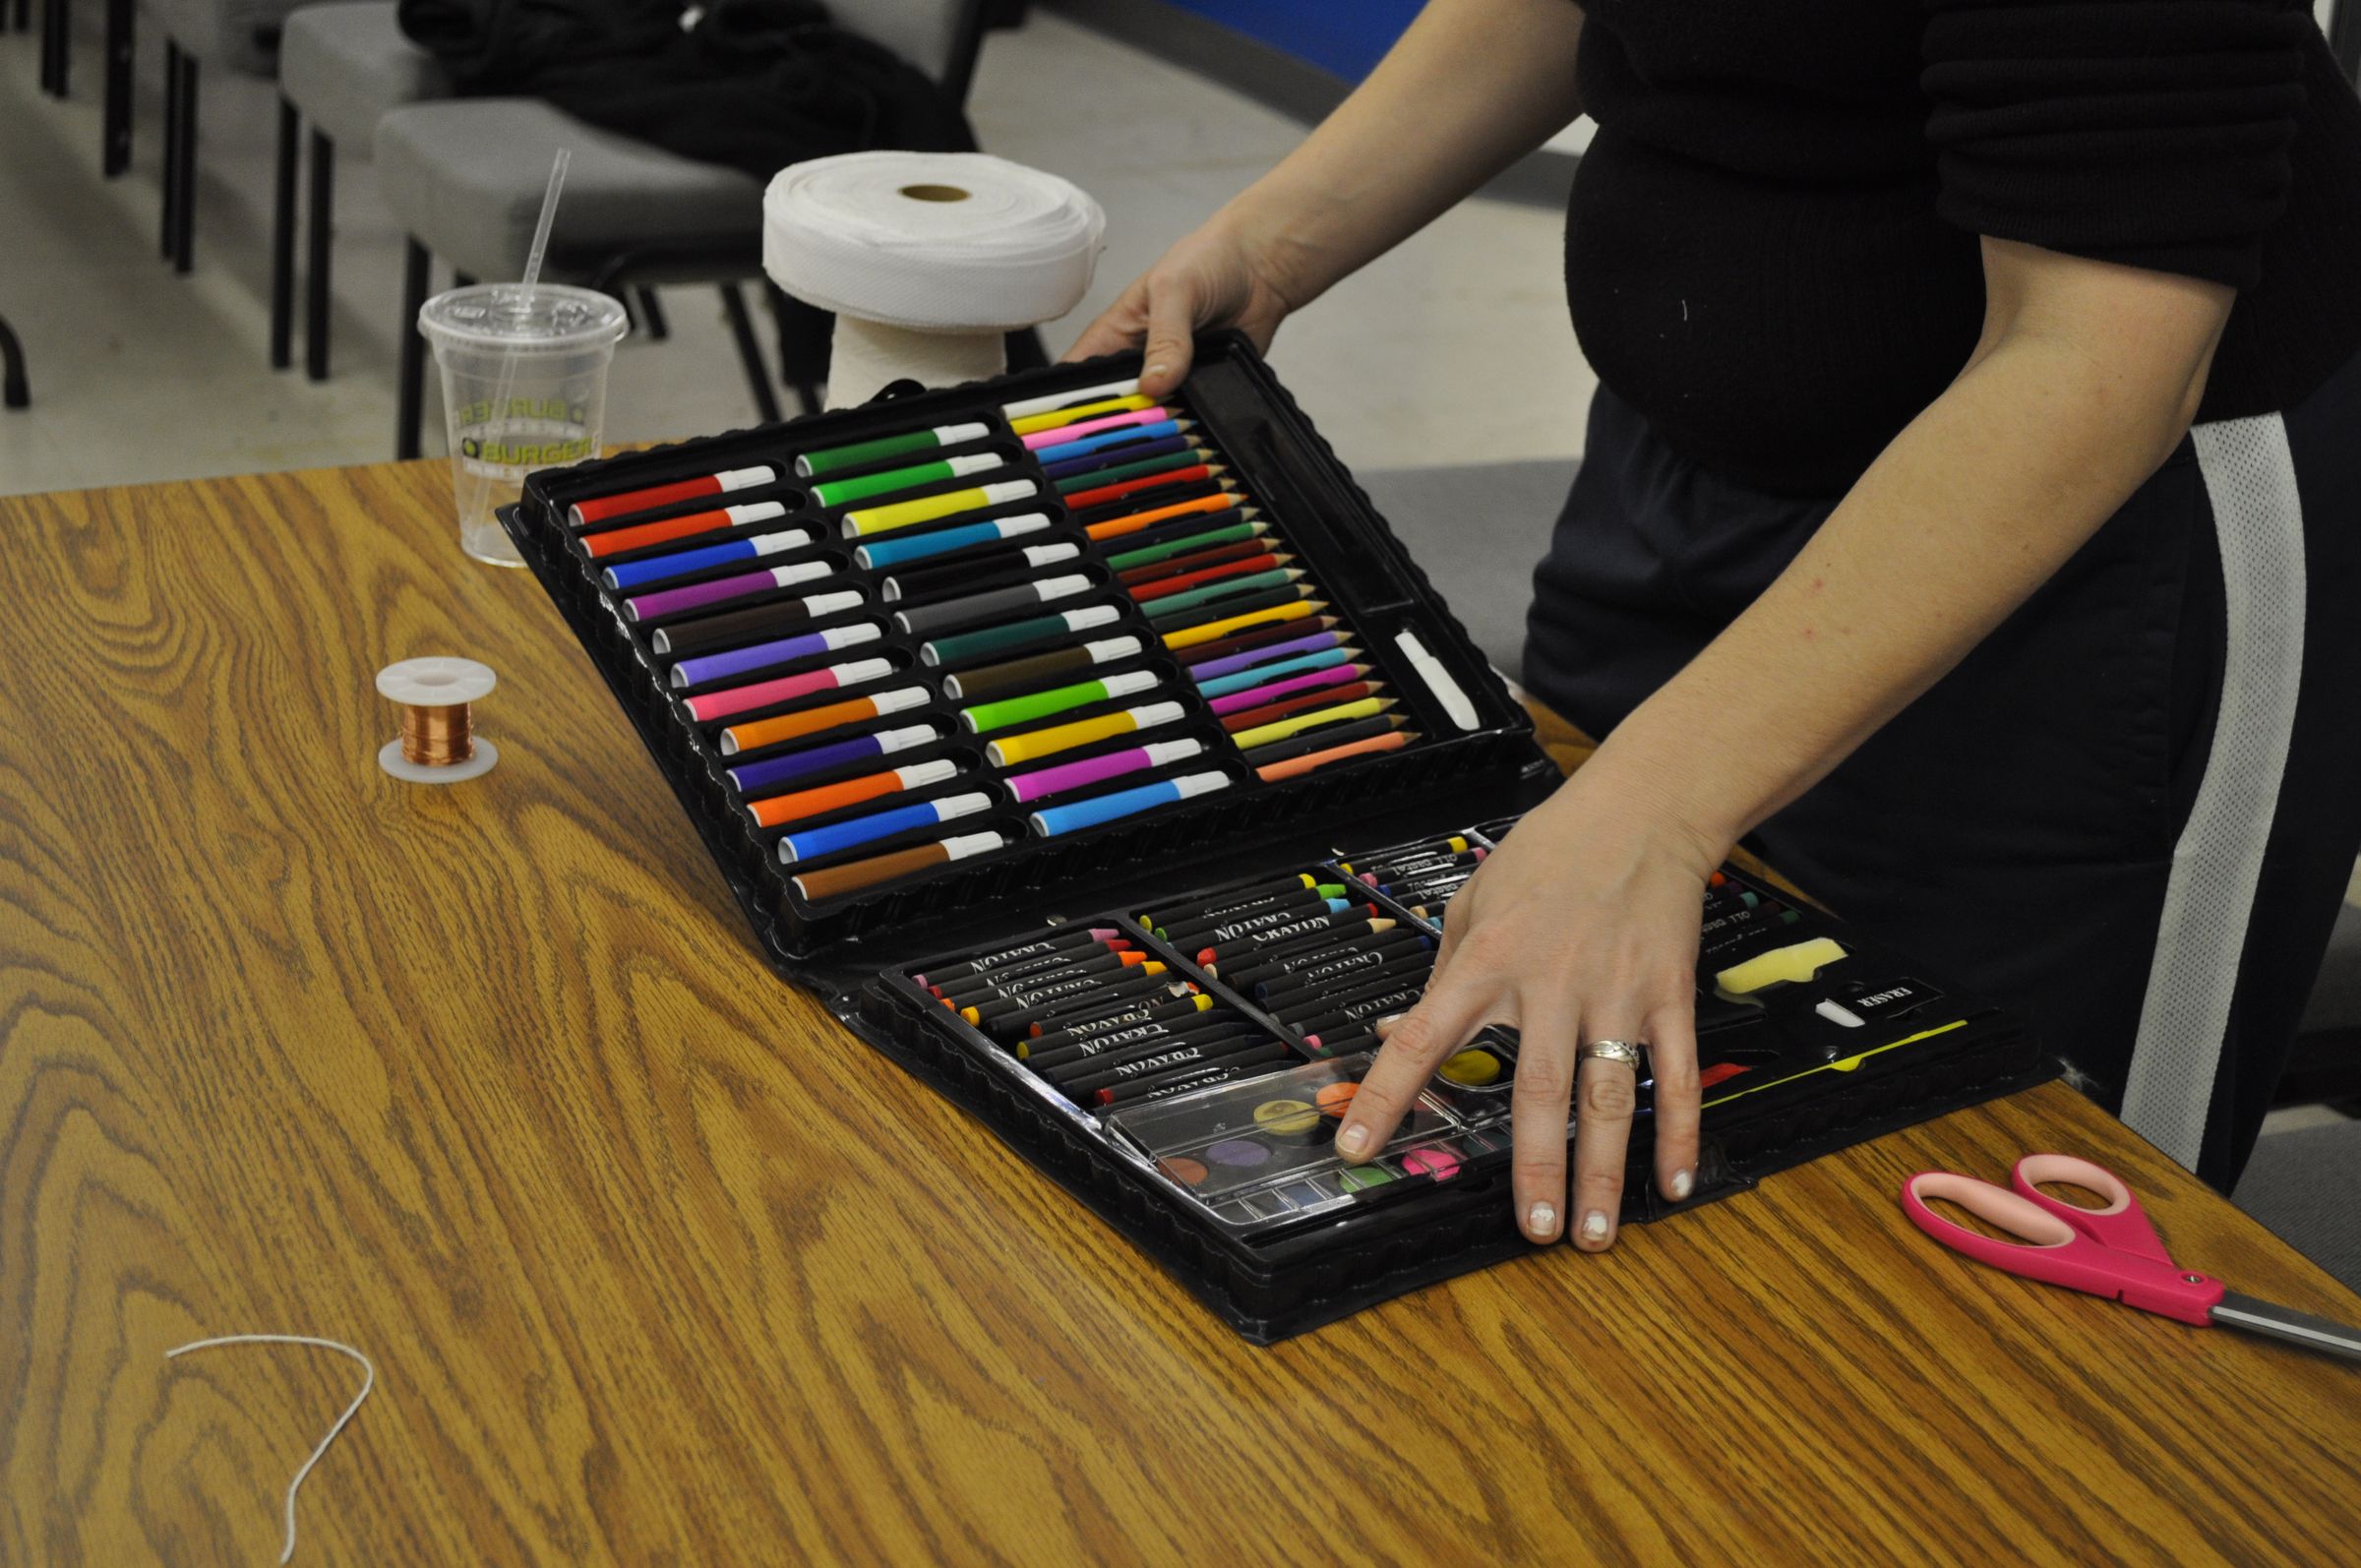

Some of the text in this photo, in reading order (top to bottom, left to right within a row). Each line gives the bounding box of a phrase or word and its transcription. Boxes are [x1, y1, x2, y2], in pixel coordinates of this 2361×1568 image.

[1857, 987, 1912, 1007] ERASER
[1066, 1008, 1152, 1037] CRAYON
[1115, 1047, 1203, 1077] CRAYON
